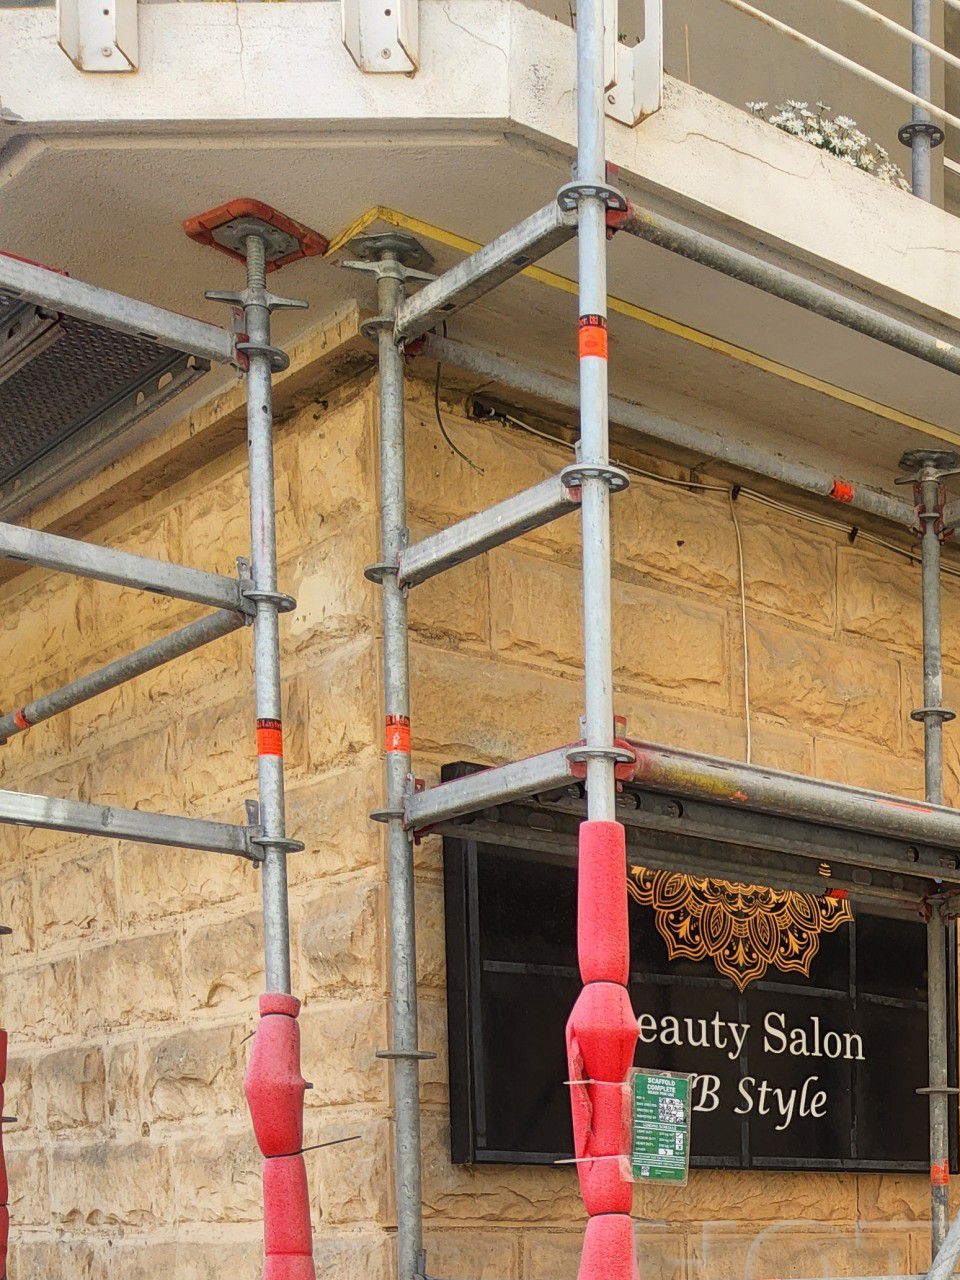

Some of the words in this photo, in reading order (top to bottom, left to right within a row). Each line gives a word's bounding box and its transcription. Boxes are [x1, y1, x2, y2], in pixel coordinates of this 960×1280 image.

[637, 1011, 750, 1060] eauty
[764, 1011, 866, 1060] Salon
[647, 1077, 676, 1087] SCAFFOLD
[691, 1074, 721, 1112] B
[734, 1075, 827, 1131] Style
